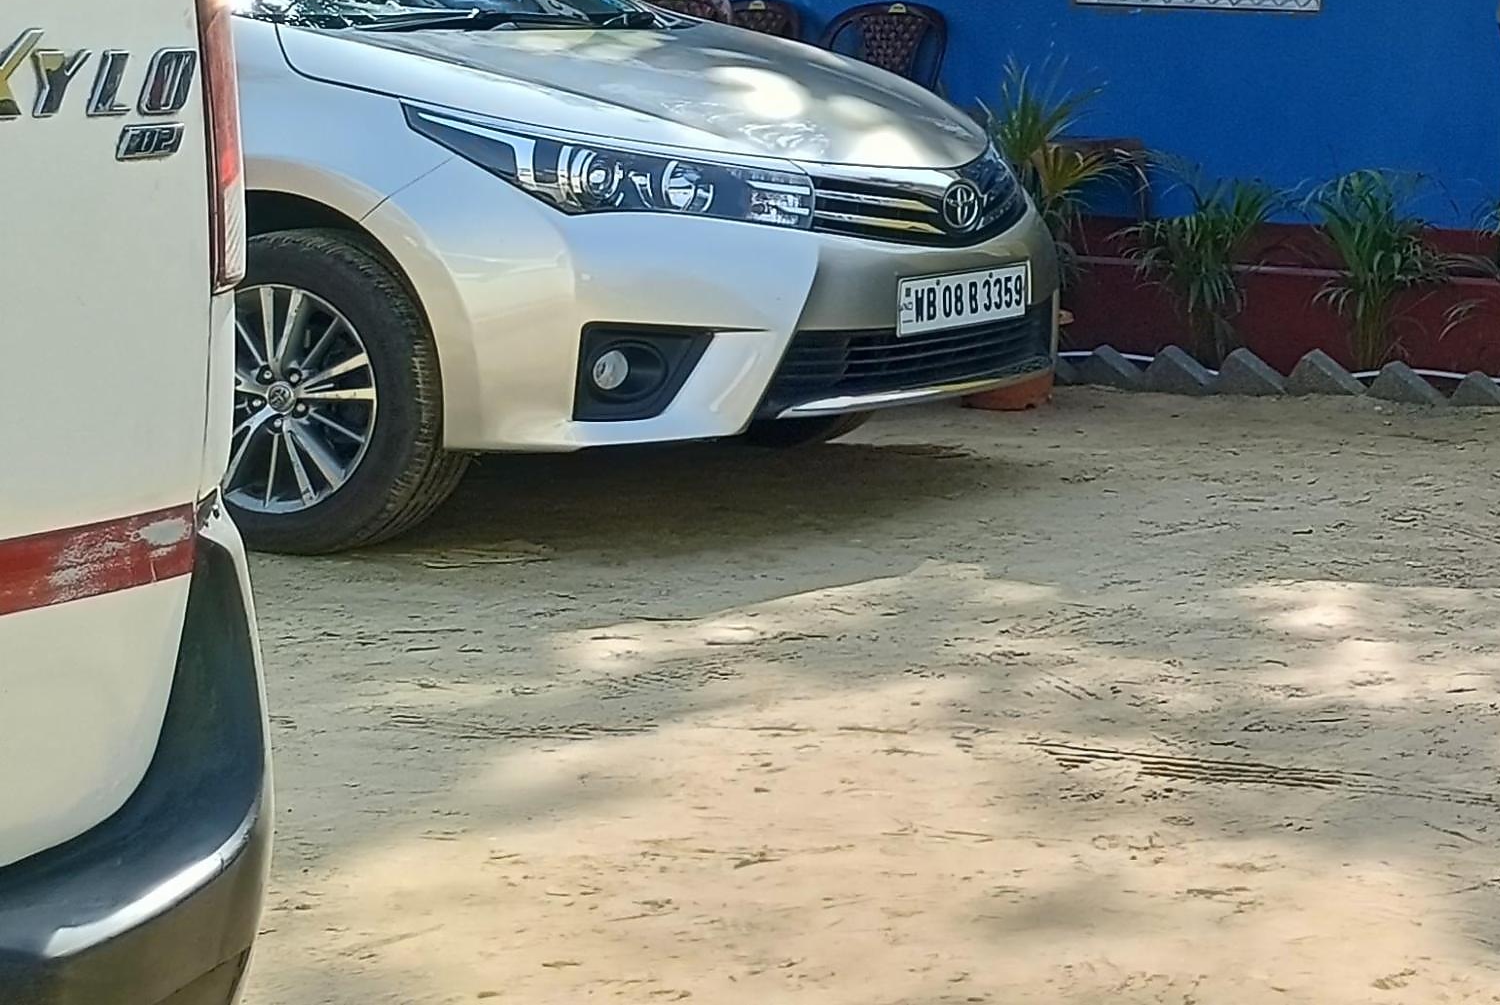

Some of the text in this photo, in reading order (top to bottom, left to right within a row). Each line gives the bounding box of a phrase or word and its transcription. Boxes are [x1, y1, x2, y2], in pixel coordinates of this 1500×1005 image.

[914, 274, 1024, 323] WB 08 B 3359
